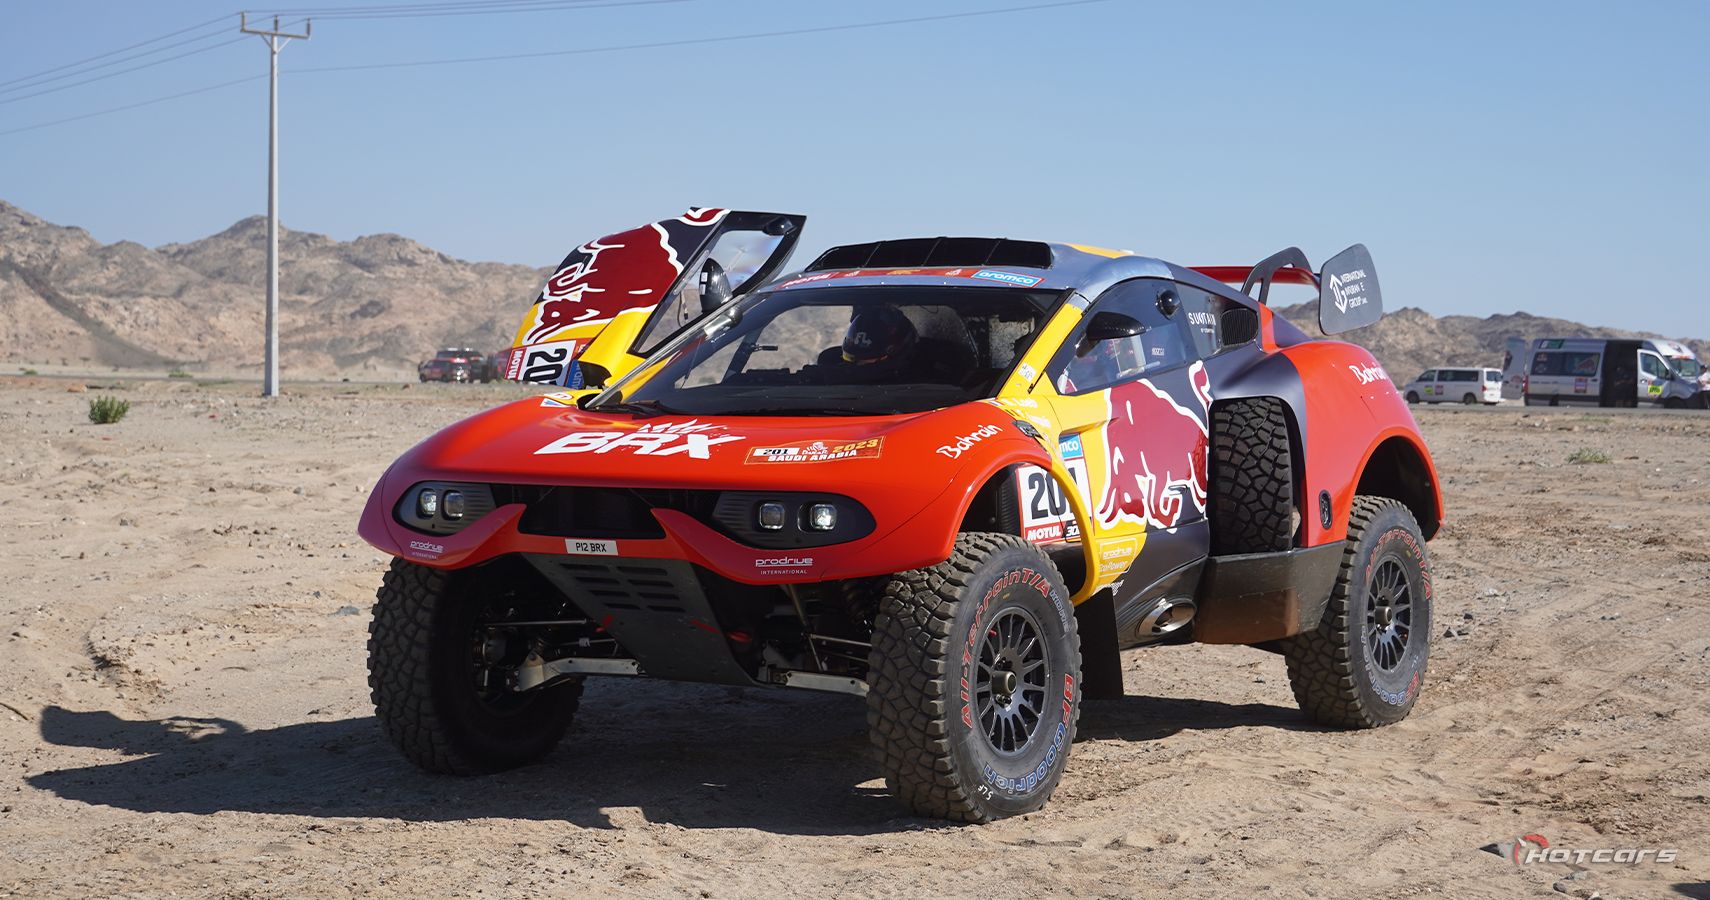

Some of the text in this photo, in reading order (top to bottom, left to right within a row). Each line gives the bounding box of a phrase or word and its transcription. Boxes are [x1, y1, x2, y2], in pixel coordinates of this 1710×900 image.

[979, 270, 1035, 285] aramco
[522, 348, 568, 386] 20
[533, 431, 746, 460] BRX
[763, 448, 789, 456] 201
[832, 438, 879, 454] 2023
[935, 424, 1003, 459] Bahrain
[767, 449, 857, 462] SAUDI ARABIA
[1027, 524, 1062, 542] MOTUL
[575, 542, 607, 553] P12 BRX
